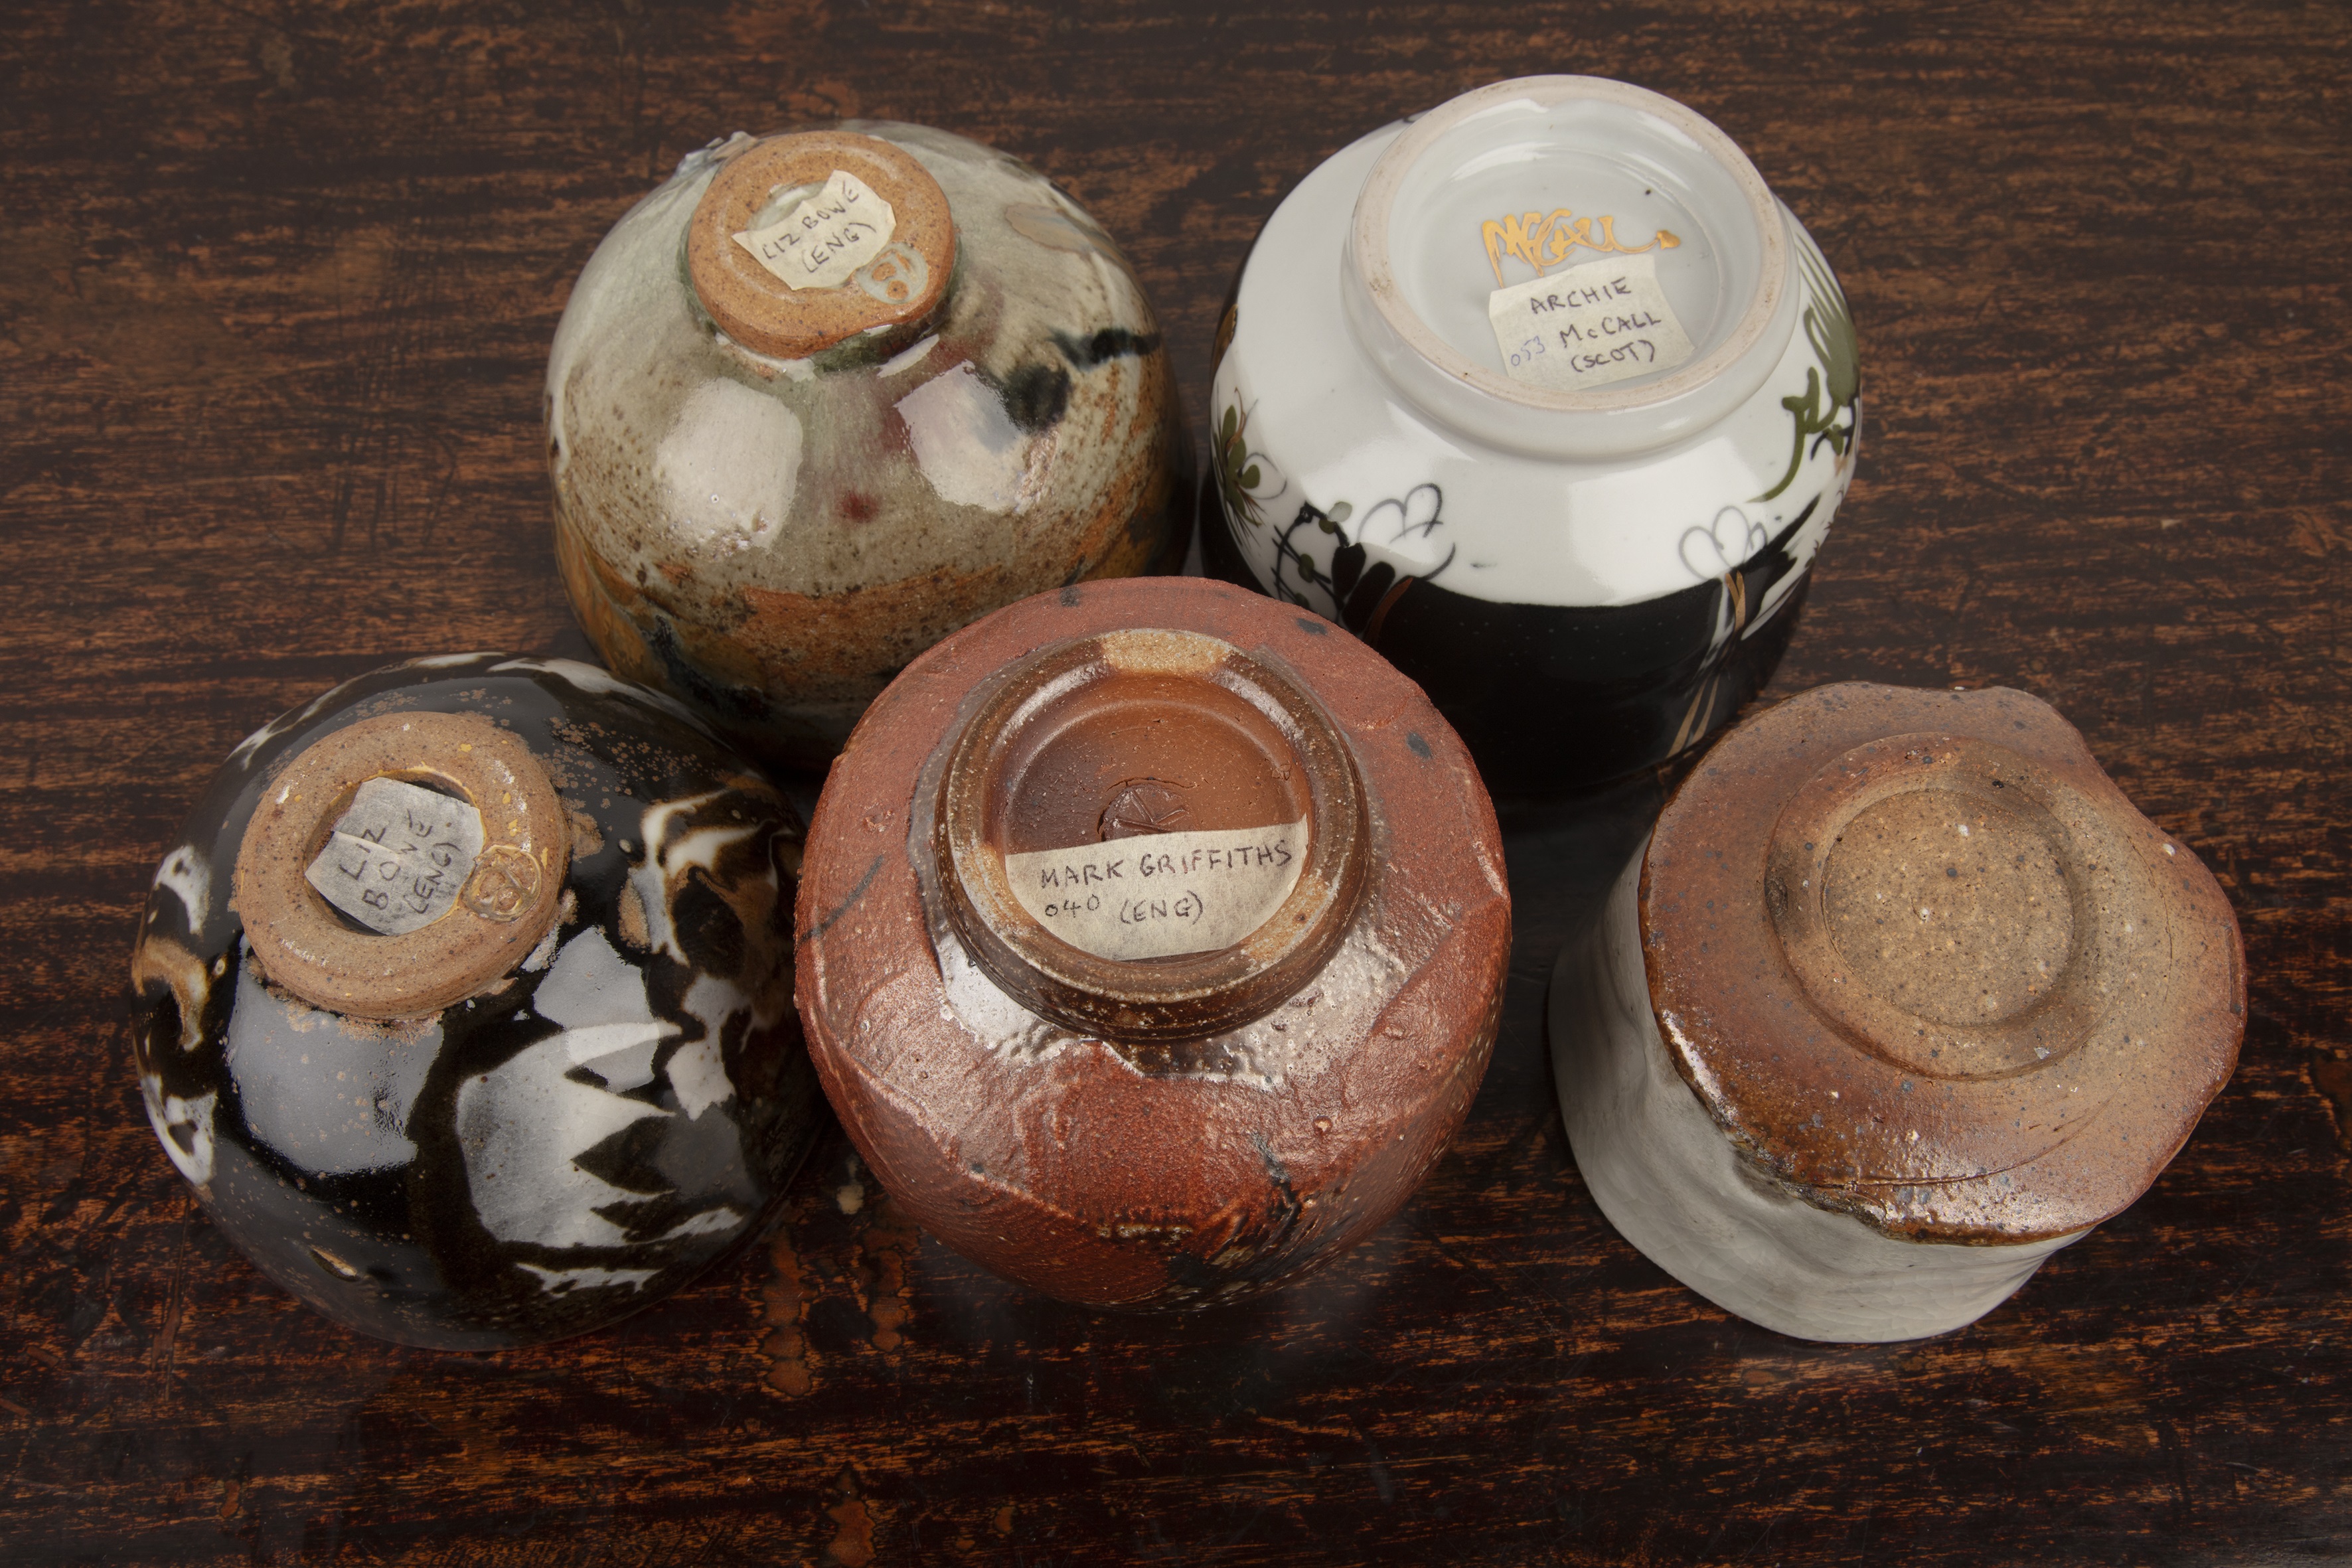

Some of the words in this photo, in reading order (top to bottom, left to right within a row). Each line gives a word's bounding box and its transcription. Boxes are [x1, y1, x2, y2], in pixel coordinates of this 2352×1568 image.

[762, 233, 801, 260] LIZ
[801, 180, 859, 230] BOWE
[802, 222, 877, 273] (ENG)
[1530, 276, 1631, 314] ARCHIE
[1571, 339, 1656, 372] (SCOT)
[339, 827, 386, 880] LIZ
[404, 842, 462, 914] (ENG)
[1040, 859, 1124, 889] MARK
[1139, 839, 1293, 878] GRIFFITHS
[1044, 894, 1101, 919] 040
[1120, 890, 1204, 925] (ENG)
